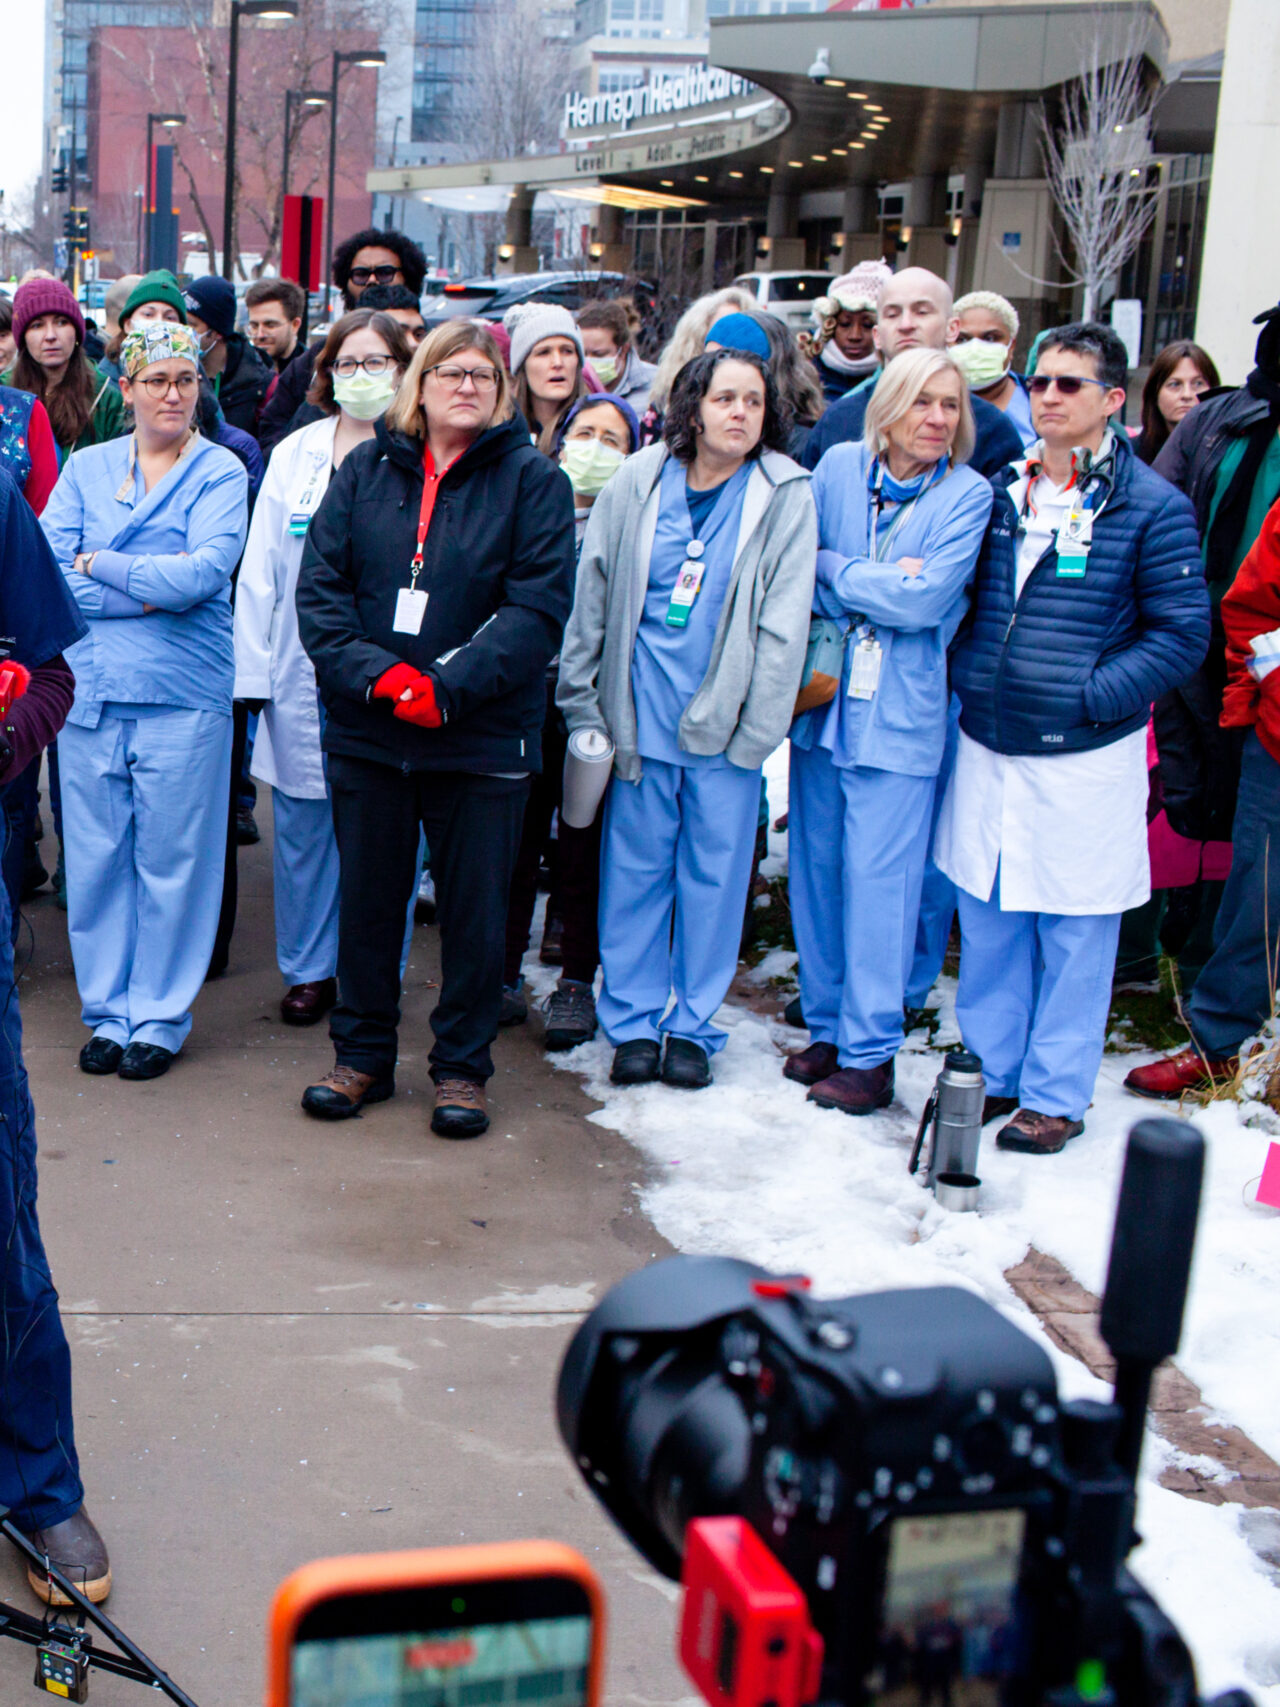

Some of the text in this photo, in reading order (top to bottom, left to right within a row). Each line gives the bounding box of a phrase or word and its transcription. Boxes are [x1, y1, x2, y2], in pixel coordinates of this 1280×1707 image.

[564, 61, 742, 131] Hennepin Healthcare
[575, 151, 606, 172] Level
